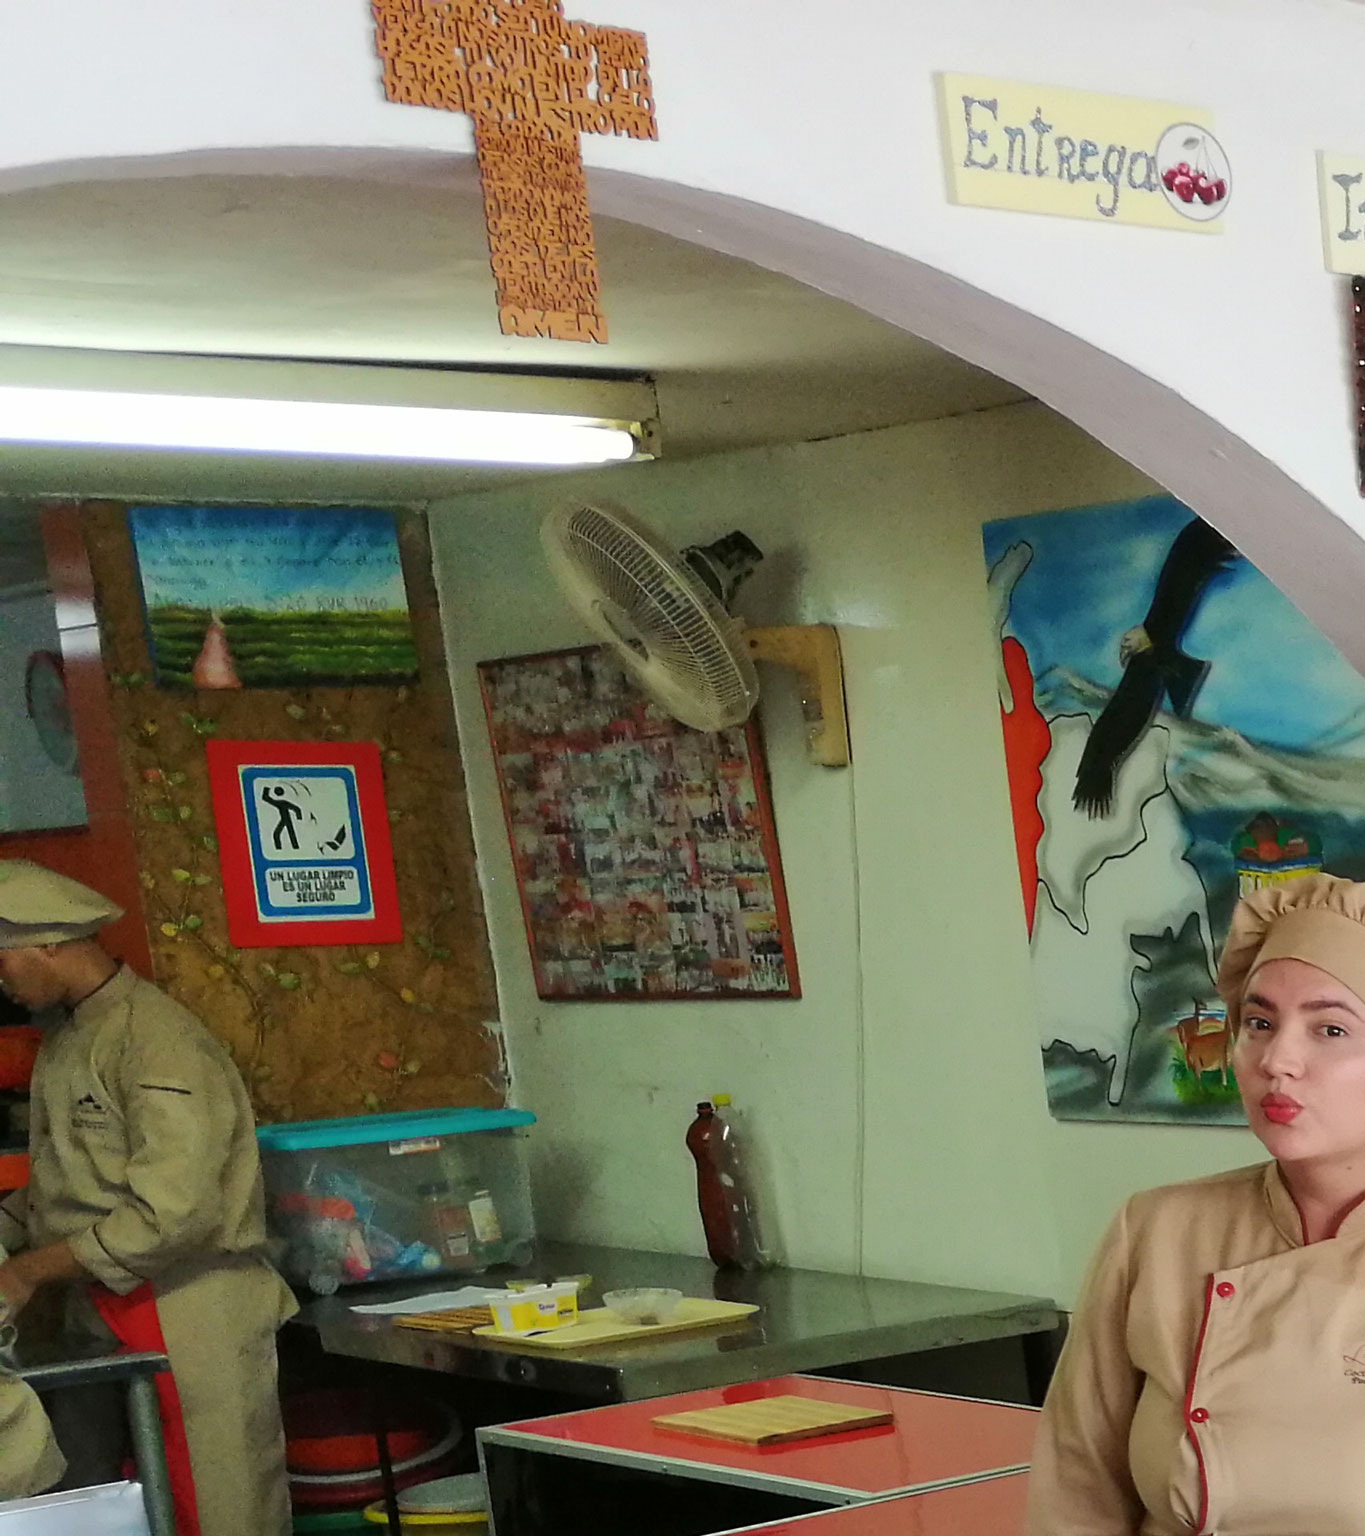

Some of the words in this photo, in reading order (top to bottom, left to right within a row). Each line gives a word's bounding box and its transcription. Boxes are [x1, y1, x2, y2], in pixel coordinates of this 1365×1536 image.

[962, 95, 1158, 216] Entrega
[498, 304, 609, 345] AMEN
[270, 871, 284, 882] UN
[287, 871, 320, 882] LUGAR
[323, 870, 354, 881] LIMPIO
[283, 882, 294, 893] ES
[299, 881, 312, 892] UN
[314, 880, 346, 891] LUGAR
[296, 892, 336, 903] SEGURO
